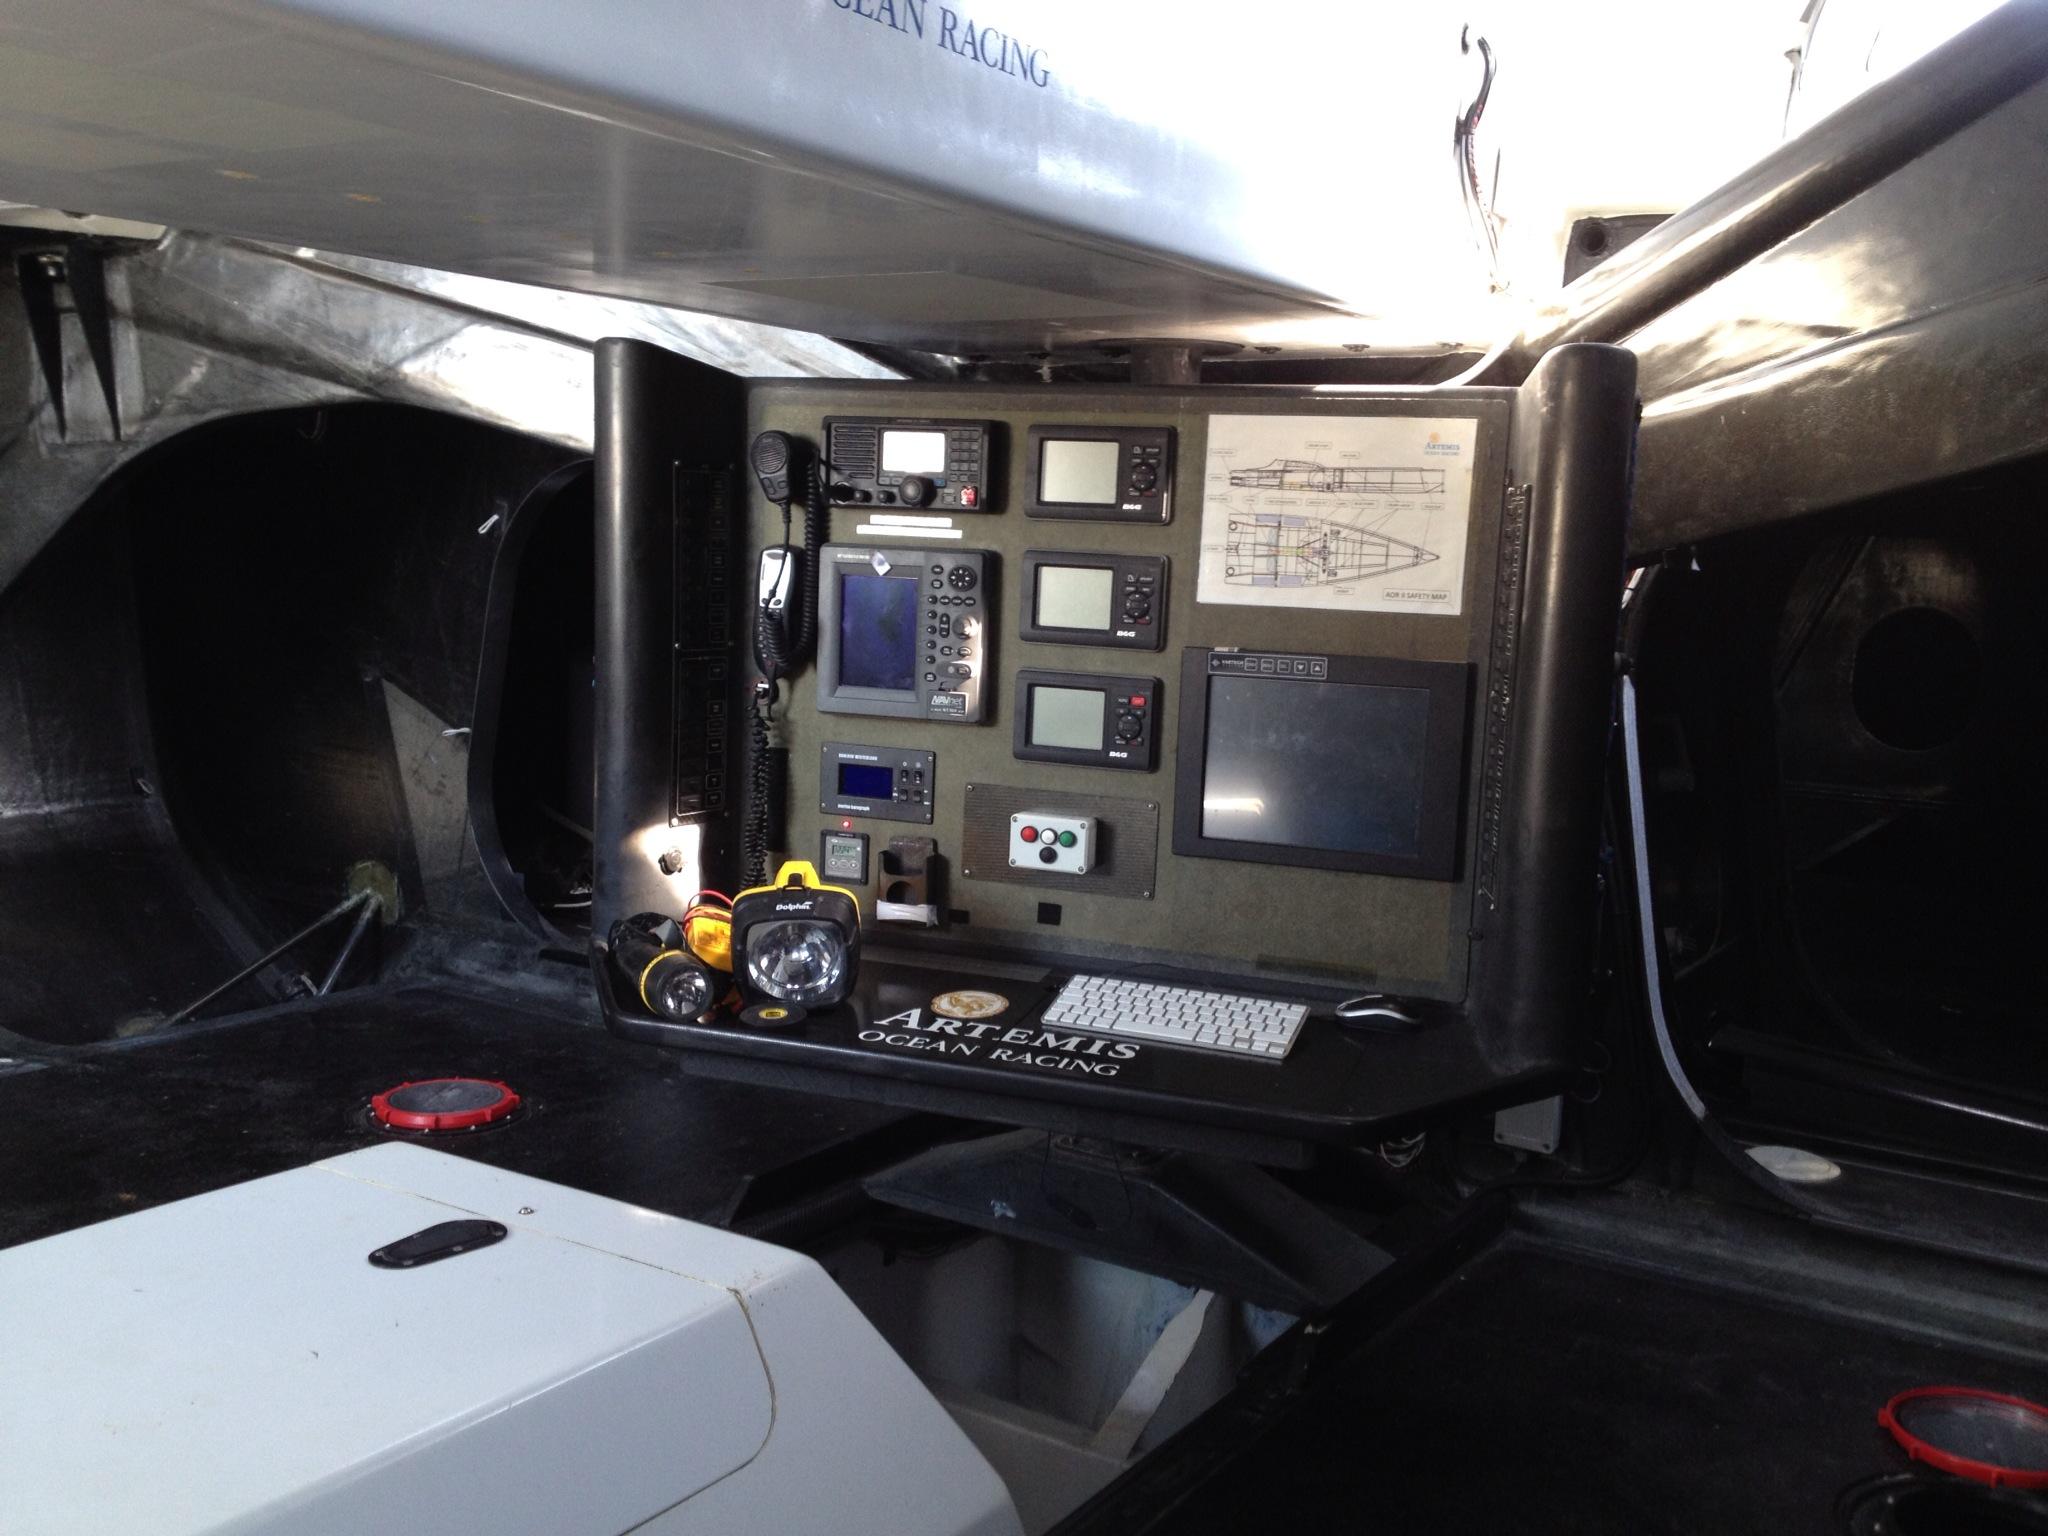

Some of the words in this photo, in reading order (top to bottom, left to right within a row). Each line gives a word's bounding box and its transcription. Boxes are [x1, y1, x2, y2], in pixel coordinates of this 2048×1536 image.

[833, 0, 928, 39] AN
[938, 6, 1051, 88] RACING
[775, 901, 813, 912] Dolphin
[857, 1029, 981, 1057] OCEAN
[988, 1047, 1121, 1077] RACING
[873, 1007, 1141, 1060] ARTEMIS
